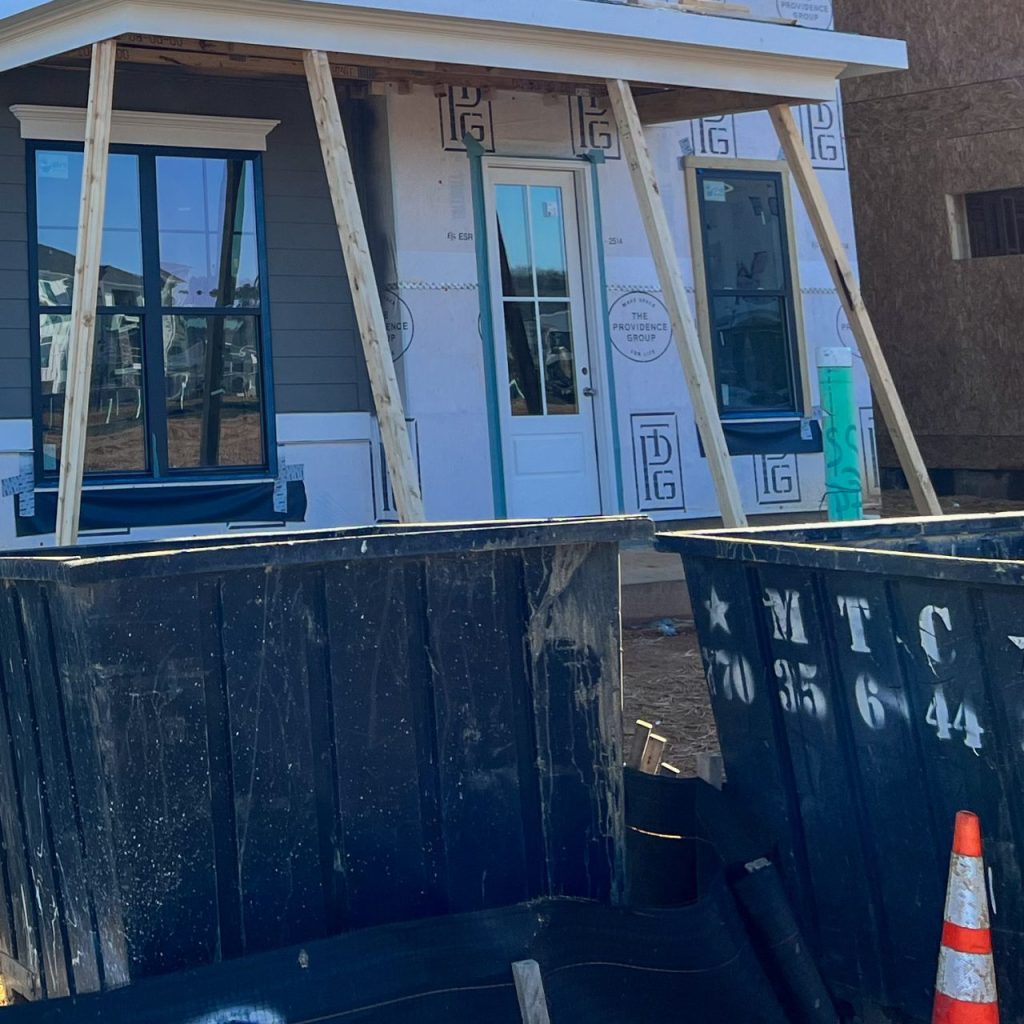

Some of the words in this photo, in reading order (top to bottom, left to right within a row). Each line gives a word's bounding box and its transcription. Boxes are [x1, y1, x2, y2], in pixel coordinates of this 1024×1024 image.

[780, 1, 829, 14] PROVIDENCE
[792, 11, 818, 21] GROUP
[631, 311, 649, 321] THE
[612, 322, 669, 332] PROVIDENCE
[626, 333, 657, 343] GROUP
